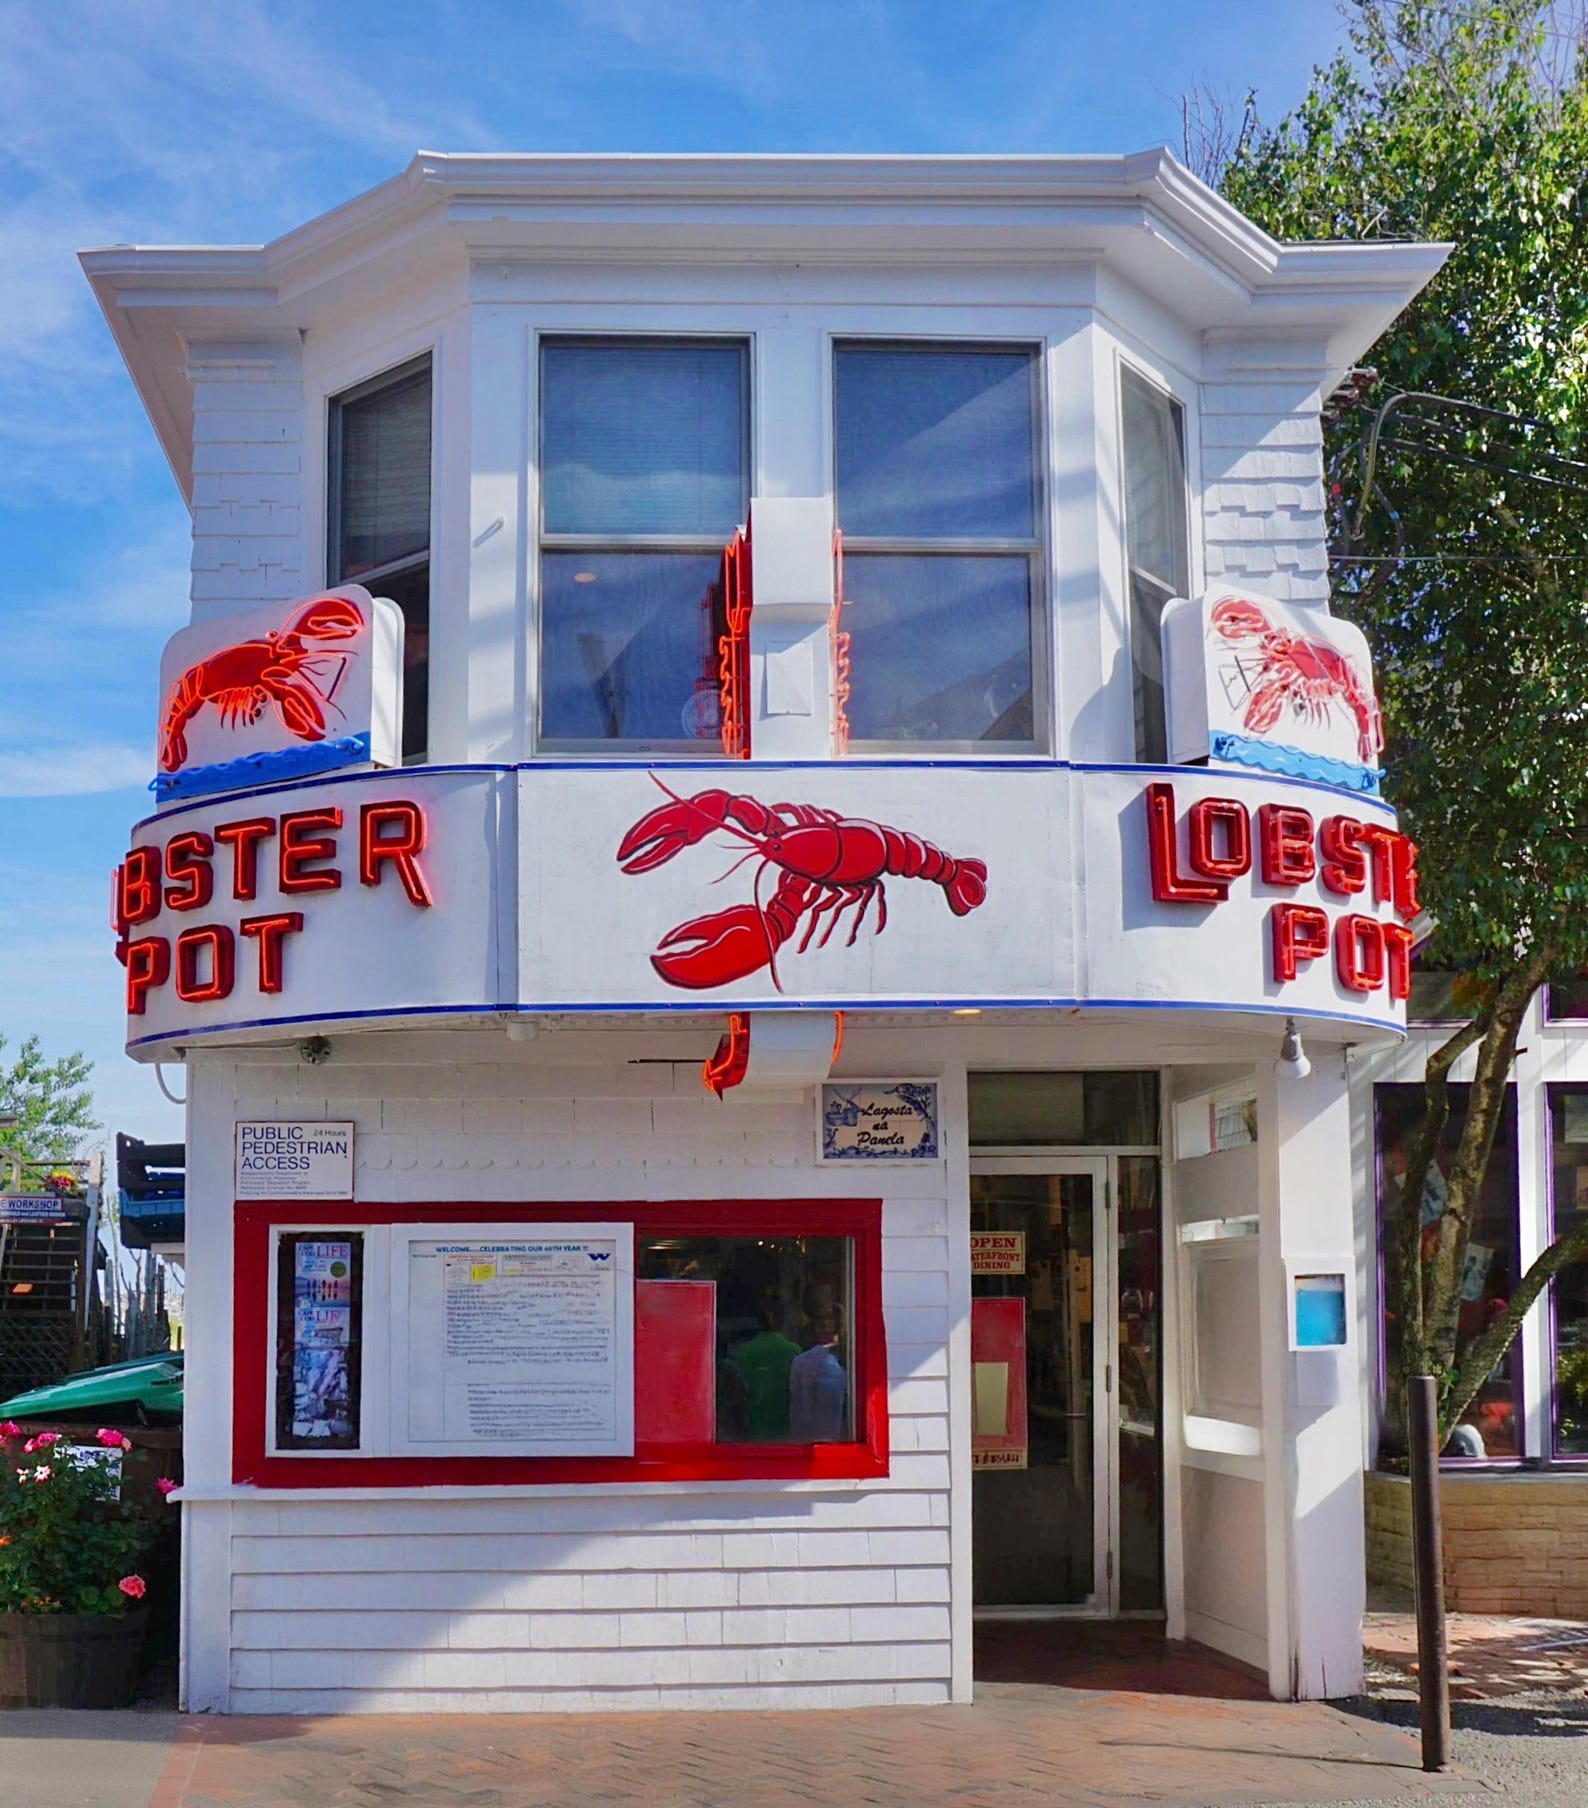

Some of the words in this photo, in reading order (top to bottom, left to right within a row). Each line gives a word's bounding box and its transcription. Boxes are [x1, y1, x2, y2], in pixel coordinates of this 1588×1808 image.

[1272, 902, 1416, 1000] POT
[126, 912, 304, 1014] POT
[861, 1102, 913, 1120] Lagosta
[241, 1126, 303, 1140] PUBLIC
[313, 1129, 323, 1137] 24
[324, 1129, 347, 1137] Hours
[241, 1141, 347, 1155] PEDESTRIAN
[241, 1156, 311, 1170] ACCESS
[9, 1199, 59, 1209] WORKSHOP
[971, 1237, 1016, 1248] OPEN
[316, 1245, 348, 1258] LIFE
[971, 1252, 1020, 1262] ATERFRONT
[973, 1261, 1010, 1269] DINING
